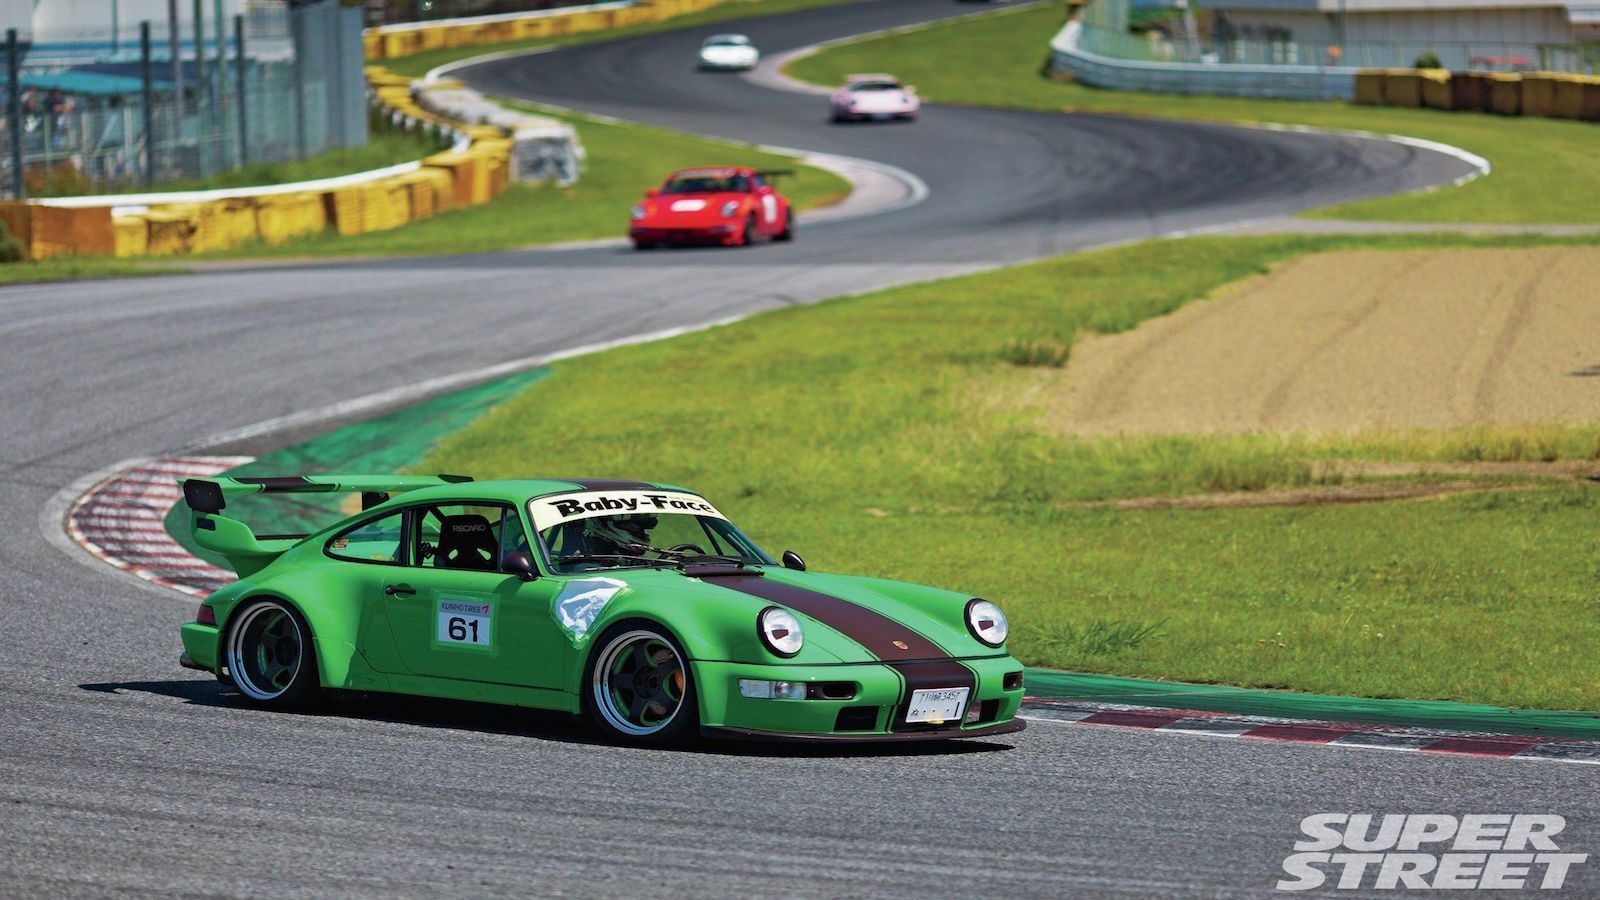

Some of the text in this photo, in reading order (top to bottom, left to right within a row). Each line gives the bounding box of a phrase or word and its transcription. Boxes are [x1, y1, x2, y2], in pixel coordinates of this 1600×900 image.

[547, 494, 715, 518] Baby-Face
[452, 523, 487, 532] RECARO
[441, 601, 481, 614] KUMHO TIRES
[448, 616, 479, 643] 61
